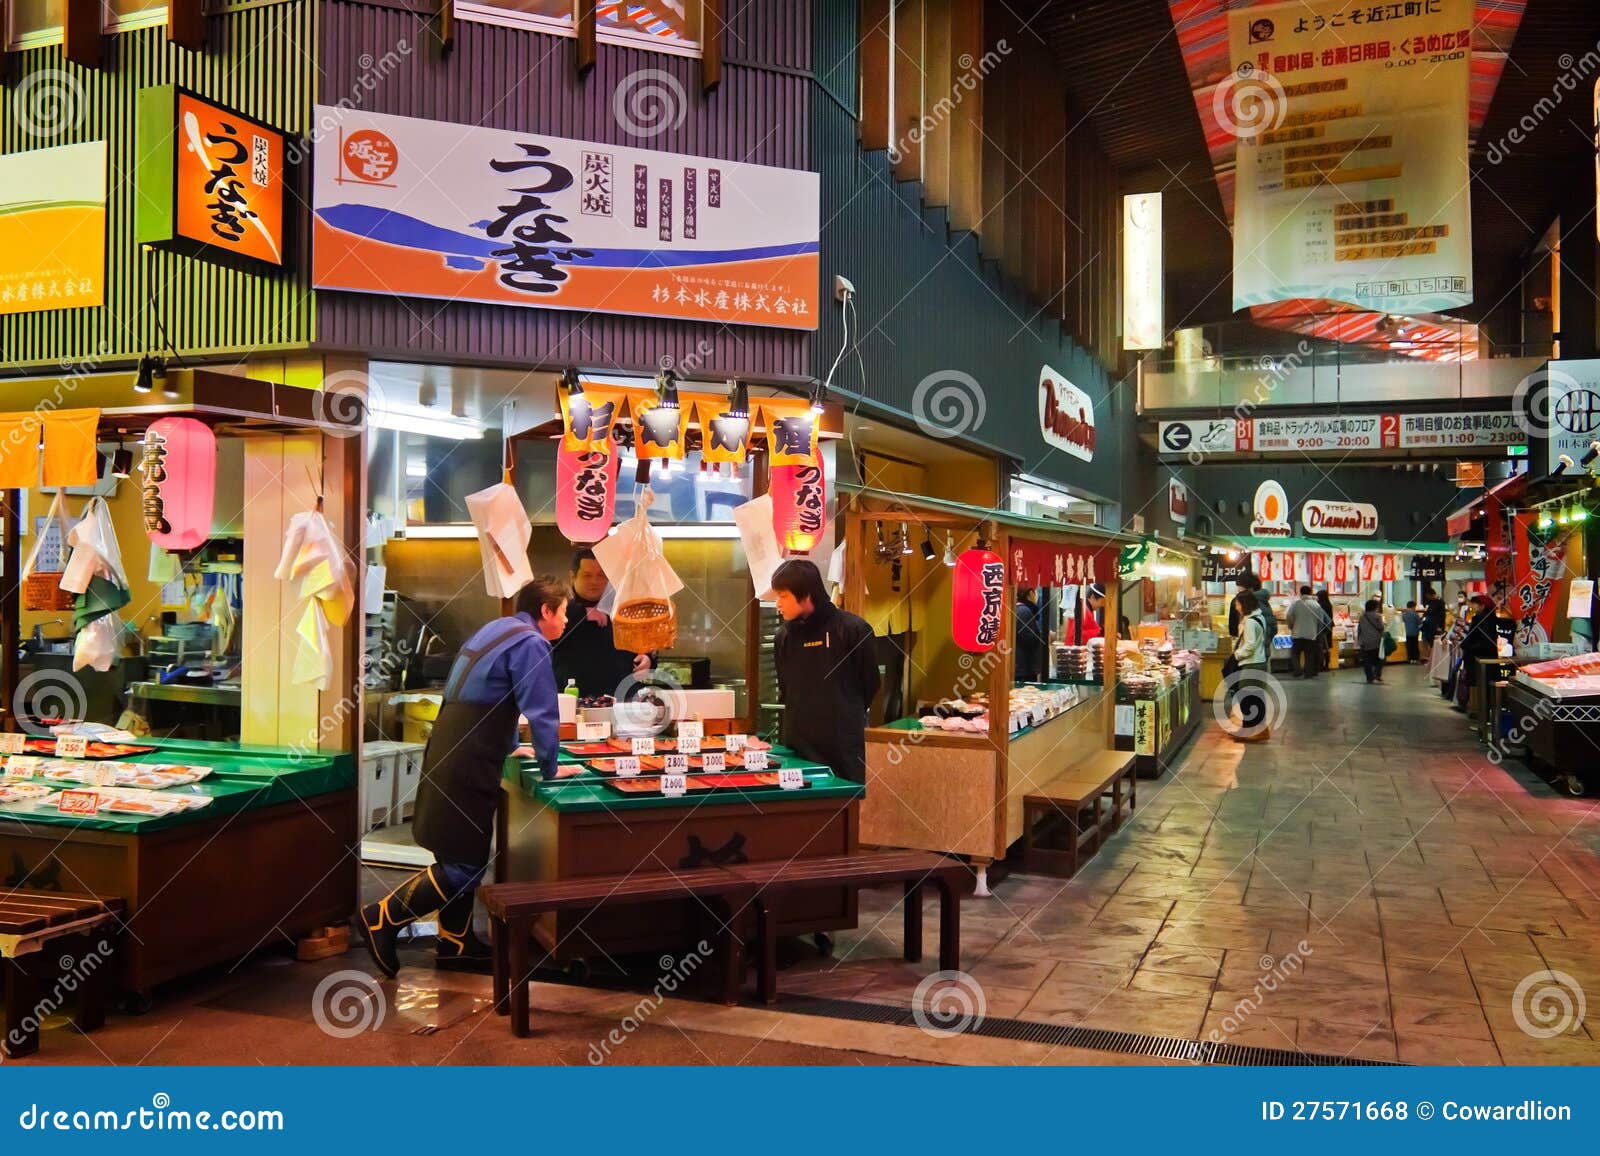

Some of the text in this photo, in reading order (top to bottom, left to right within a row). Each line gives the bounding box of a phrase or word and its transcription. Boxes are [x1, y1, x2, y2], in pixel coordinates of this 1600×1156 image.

[1293, 0, 1441, 33] ようこそ近江町に
[204, 122, 258, 242] うなぎ
[583, 154, 611, 215] 炭火焼
[636, 167, 646, 225] ずわいがに
[710, 173, 720, 204] 甘えび
[486, 142, 595, 293] うなぎ
[652, 284, 809, 316] 杉本水産株式会社
[1358, 279, 1465, 297] 近江町いちば館
[1237, 420, 1251, 438] B1
[1383, 417, 1397, 434] 2
[1307, 506, 1362, 528] Diamond
